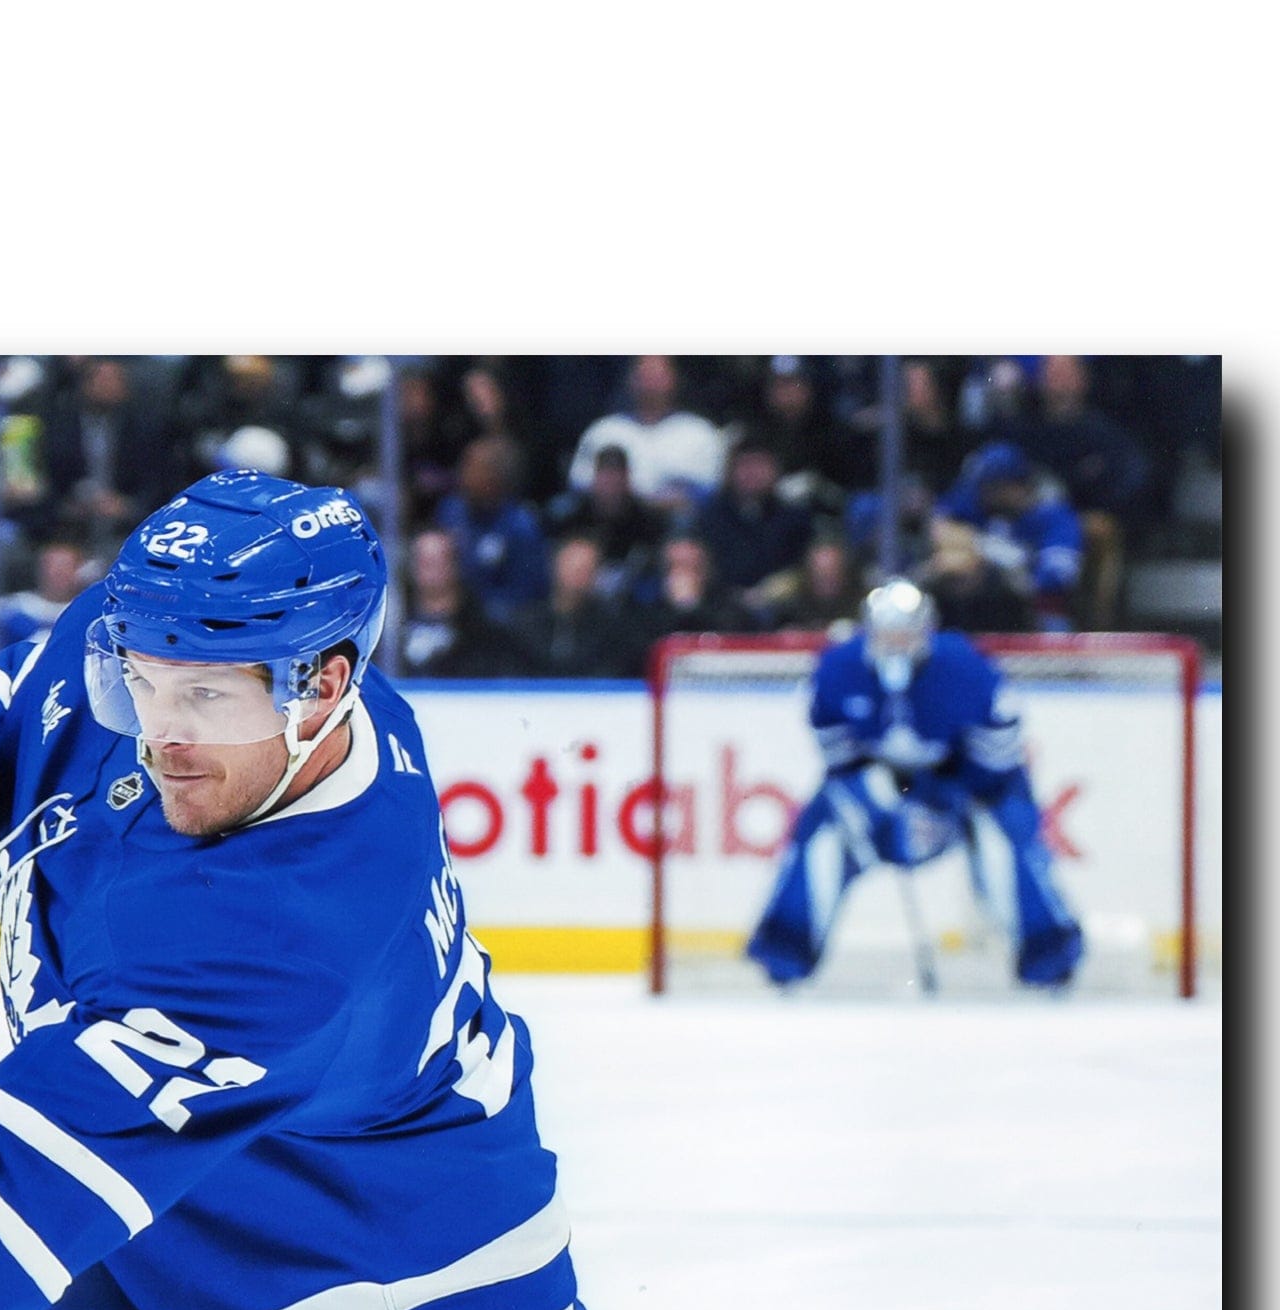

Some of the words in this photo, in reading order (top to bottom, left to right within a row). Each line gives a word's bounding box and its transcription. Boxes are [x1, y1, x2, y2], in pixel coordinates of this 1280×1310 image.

[292, 500, 361, 538] OREO
[146, 520, 209, 560] 22
[73, 1007, 268, 1134] 22
